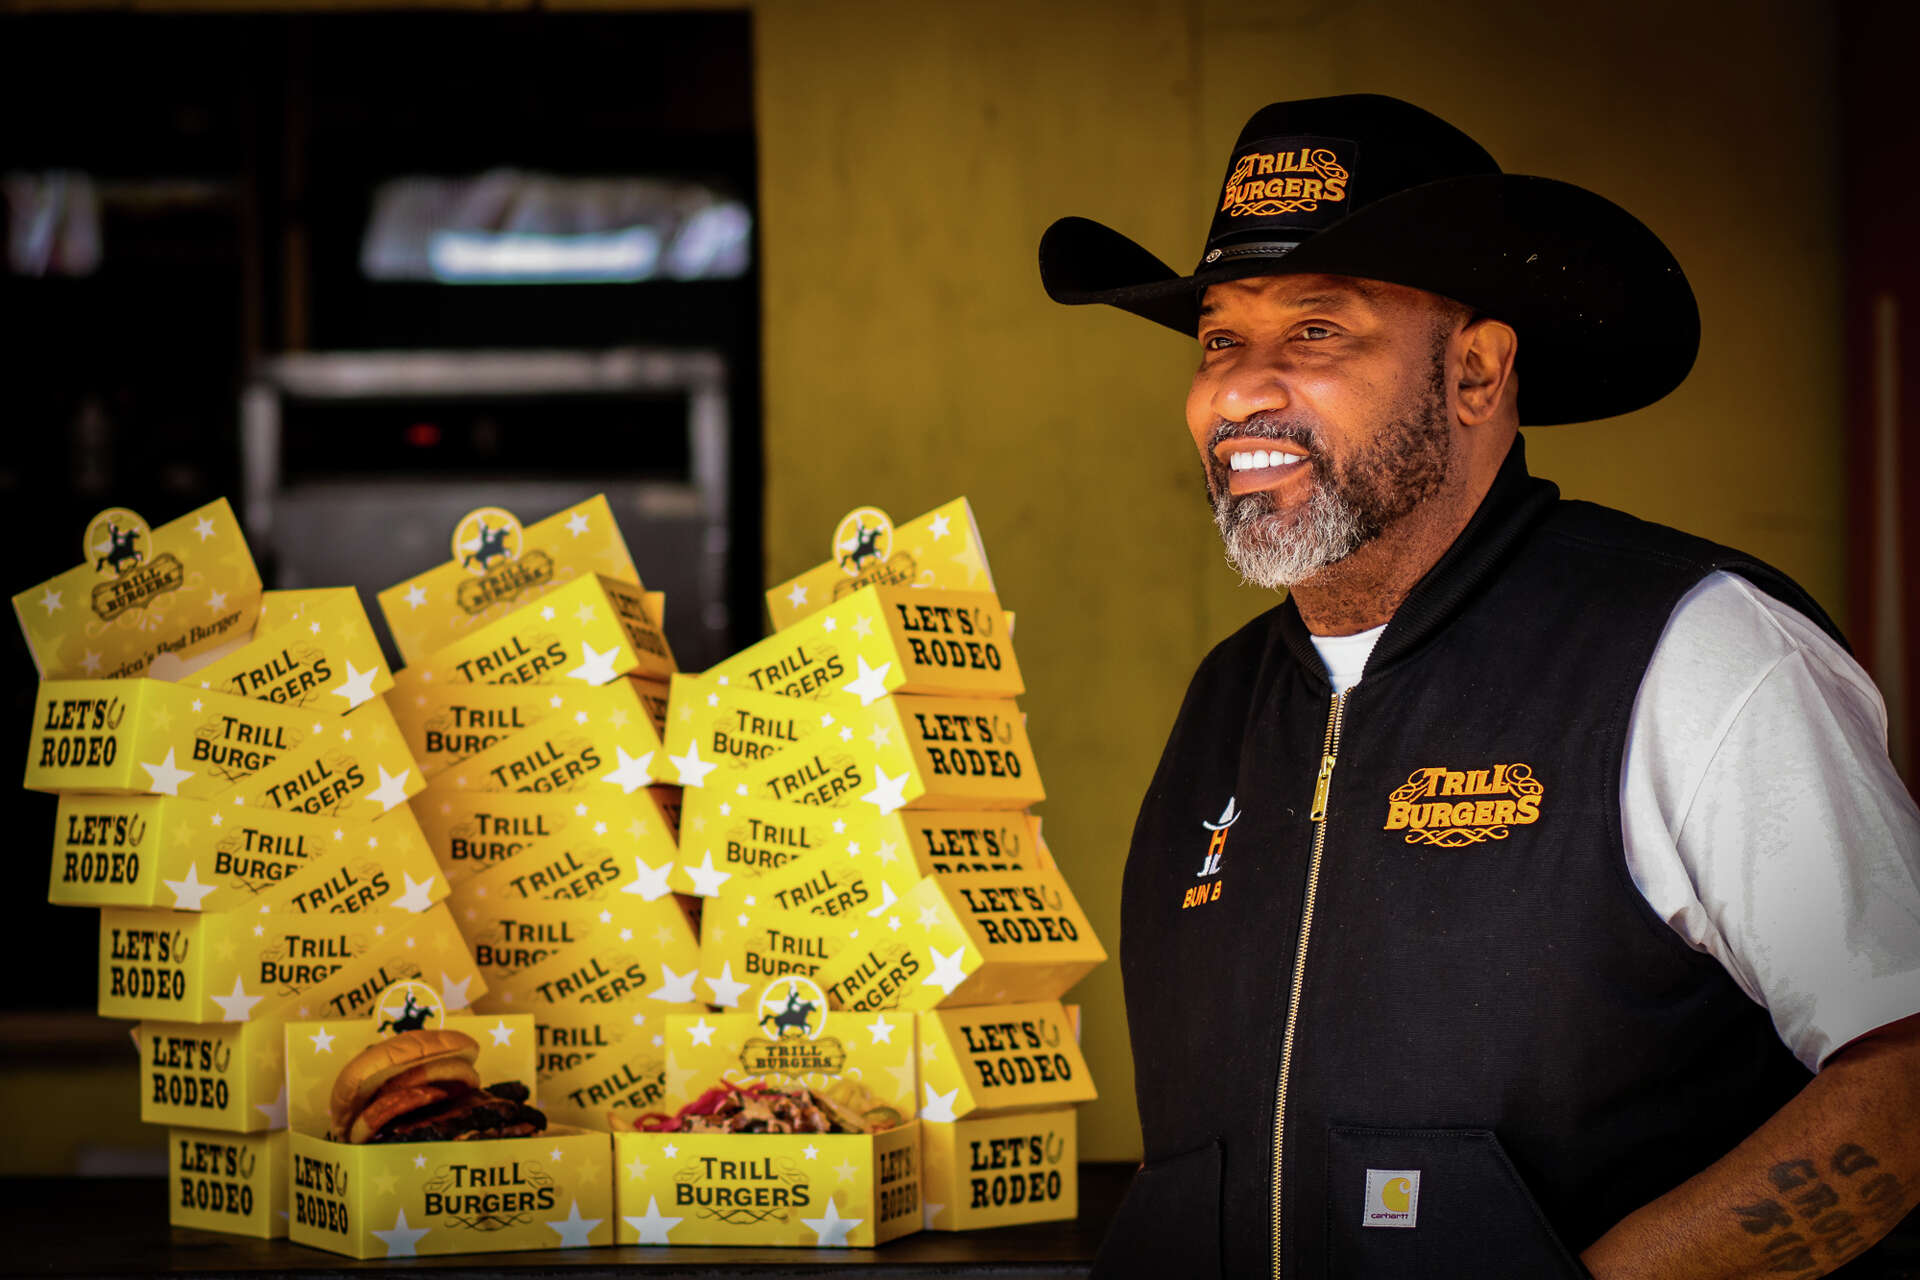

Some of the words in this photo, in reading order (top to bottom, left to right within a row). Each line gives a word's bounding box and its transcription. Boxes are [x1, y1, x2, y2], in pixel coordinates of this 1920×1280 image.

[1246, 148, 1315, 177] TRILL
[1221, 178, 1348, 212] BURGERS
[110, 568, 162, 597] TRILL
[190, 609, 243, 647] Burger
[896, 604, 975, 636] LET'S
[455, 636, 532, 684] TRILL
[488, 641, 569, 684] GERS
[748, 646, 814, 691] TRILL
[907, 638, 1002, 671] RODEO
[231, 649, 300, 696] TRILL
[256, 656, 333, 703] GERS
[774, 654, 846, 699] GERS
[44, 698, 107, 731] LET'S
[450, 706, 526, 728] TRILL
[736, 709, 799, 742] TRILL
[914, 713, 994, 744] LET'S
[221, 716, 288, 750] TRILL
[425, 730, 511, 754] BURG
[712, 731, 785, 760] BURG
[39, 736, 118, 767] RODEO
[192, 737, 279, 770] BURGE
[490, 740, 566, 789] TRILL
[926, 747, 1022, 779] RODEO
[265, 758, 334, 809] TRILL
[517, 746, 602, 793] GERS
[766, 755, 831, 801] TRILL
[792, 764, 864, 806] GERS
[1422, 764, 1509, 798] TRILL
[289, 764, 366, 814] GERS
[475, 813, 551, 836] TRILL
[1384, 795, 1542, 830] BURGERS
[66, 815, 129, 846] LET'S
[241, 828, 309, 858] TRILL
[748, 819, 812, 848] TRILL
[921, 829, 1001, 857] LET'S
[63, 852, 140, 885] RODEO
[214, 851, 305, 881] BURGE
[726, 841, 802, 869] BURG
[291, 866, 360, 914] TRILL
[510, 851, 585, 899] TRILL
[774, 869, 838, 911] TRILL
[961, 886, 1045, 914] LET'S
[1182, 884, 1210, 910] BUN
[1210, 880, 1222, 902] B
[111, 929, 173, 962] LET'S
[285, 935, 353, 958] TRILL
[499, 920, 576, 943] TRILL
[766, 929, 830, 960] TRILL
[977, 916, 1080, 945] RODEO
[110, 966, 186, 1001] RODEO
[330, 967, 397, 1017] TRILL
[535, 957, 612, 1004] TRILL
[828, 950, 888, 1006] TRILL
[847, 951, 921, 1012] RGERS
[535, 1024, 609, 1046] TRILL
[765, 1045, 824, 1057] TRILL
[960, 1022, 1043, 1054] LET'S
[152, 1036, 213, 1068] LET'S
[756, 1057, 833, 1070] BURGERS
[569, 1061, 643, 1111] TRILL
[975, 1053, 1072, 1089] RODEO
[152, 1072, 229, 1110] RODEO
[179, 1140, 239, 1177] LET'S
[700, 1156, 779, 1181] TRILL
[969, 1134, 1044, 1172] LET'S
[294, 1153, 337, 1192] LET'S
[449, 1162, 526, 1188] TRILL
[181, 1177, 254, 1217] RODEO
[424, 1186, 555, 1216] BURGERS
[675, 1182, 811, 1208] BURGERS
[970, 1169, 1064, 1210] RODEO
[295, 1191, 349, 1236] RODEO
[1370, 1212, 1409, 1220] carhartt
